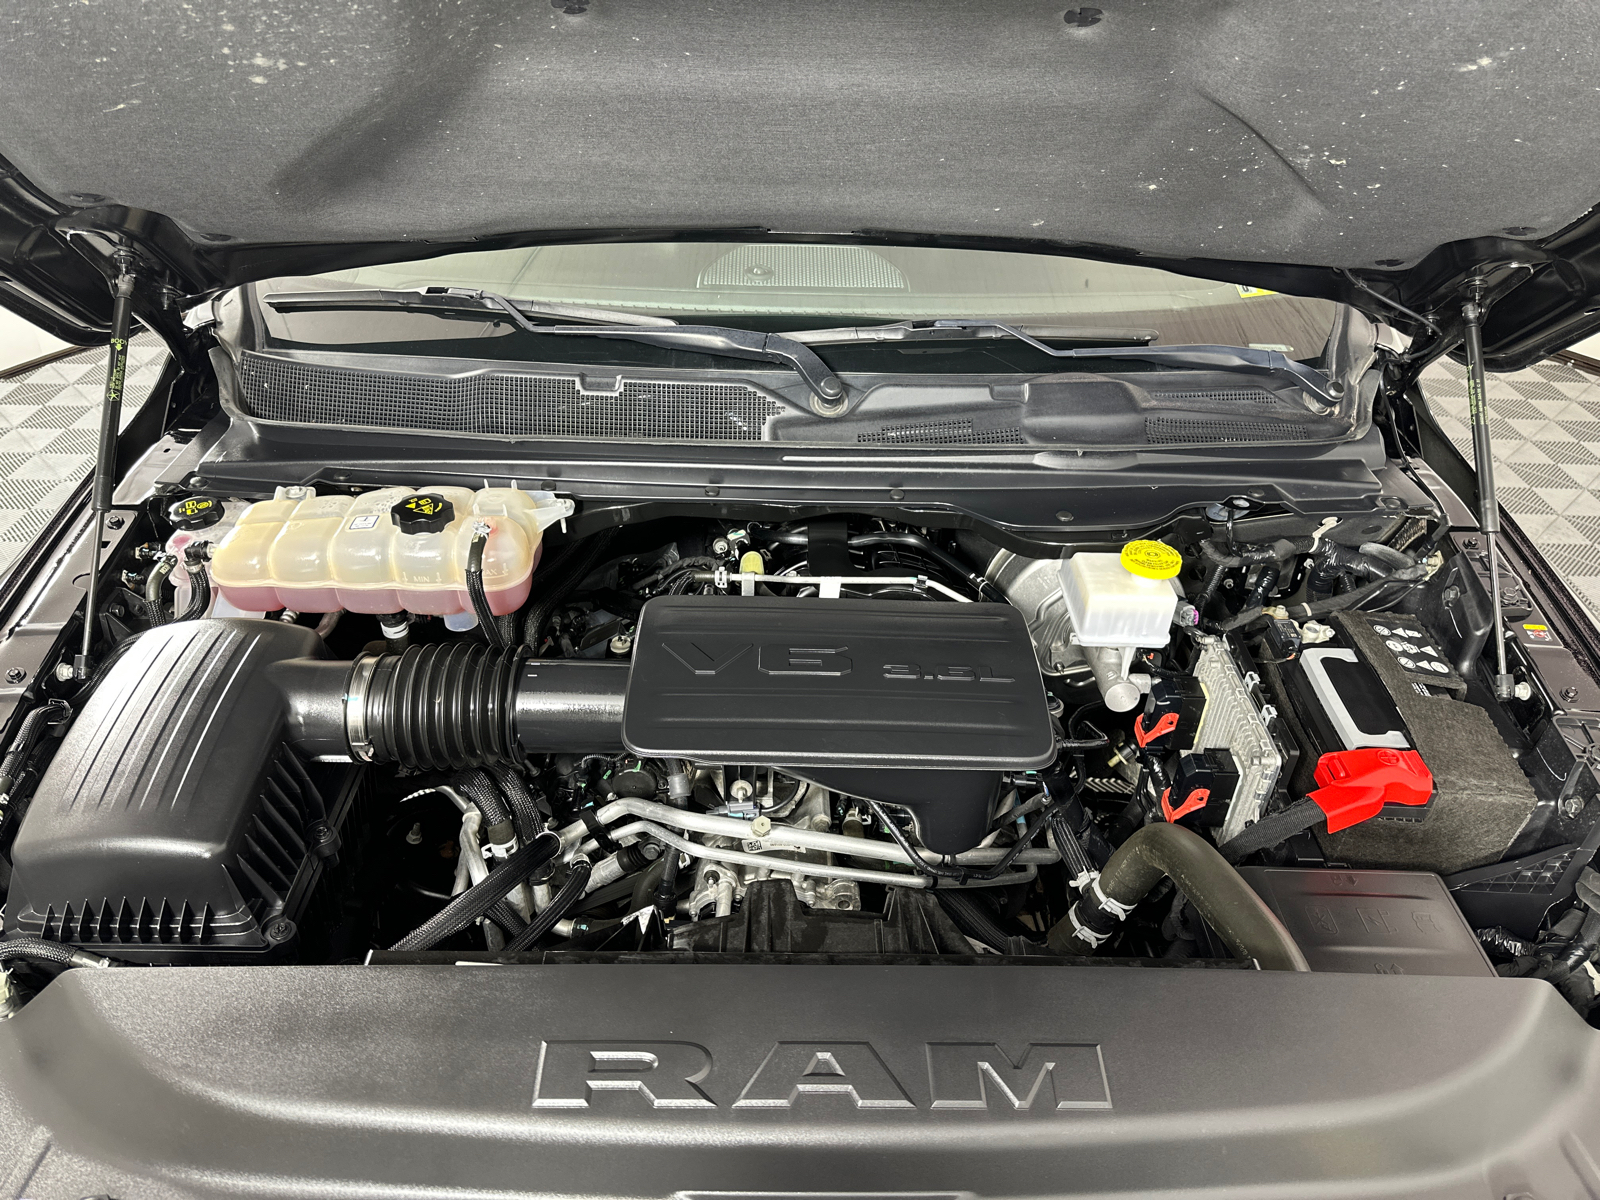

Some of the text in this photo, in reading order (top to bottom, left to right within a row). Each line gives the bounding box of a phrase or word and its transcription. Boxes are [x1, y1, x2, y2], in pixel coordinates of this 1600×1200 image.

[413, 575, 430, 583] MIN
[661, 643, 1016, 683] V6 3.6L
[532, 1040, 1113, 1109] RAM
